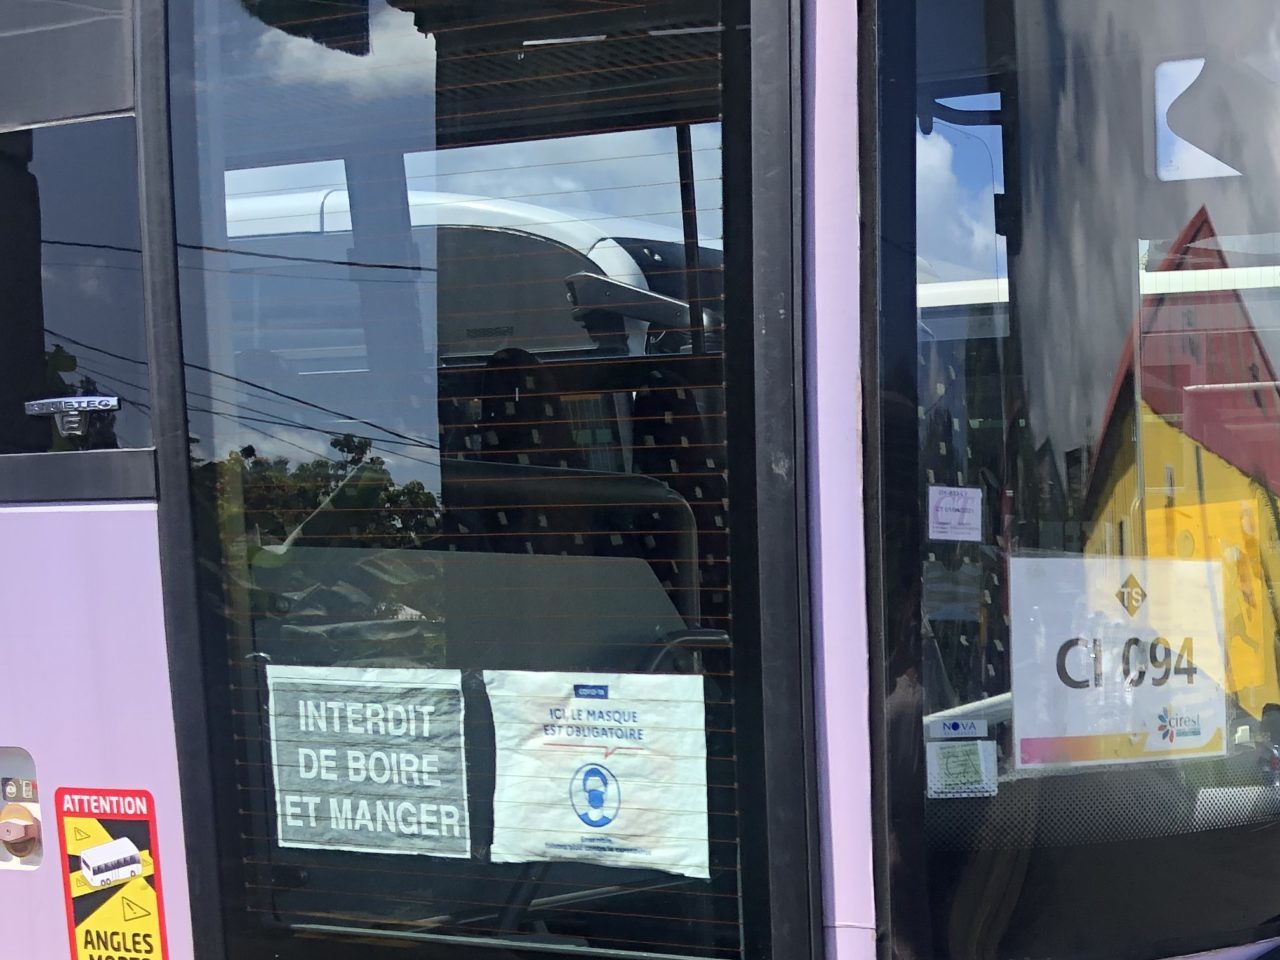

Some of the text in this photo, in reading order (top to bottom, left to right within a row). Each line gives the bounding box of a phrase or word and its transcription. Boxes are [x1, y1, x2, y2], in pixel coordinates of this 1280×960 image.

[1121, 588, 1143, 607] TS
[1056, 637, 1197, 689] CI 094
[299, 700, 435, 737] INTERDIT
[571, 709, 583, 721] LE
[586, 710, 638, 724] MASQUE
[543, 726, 644, 740] EST OBLIGATOIRE
[299, 748, 441, 787] DE BOIRE
[63, 794, 148, 815] ATTENTION
[285, 795, 460, 837] ET MANGER
[84, 929, 154, 954] ANGLES
